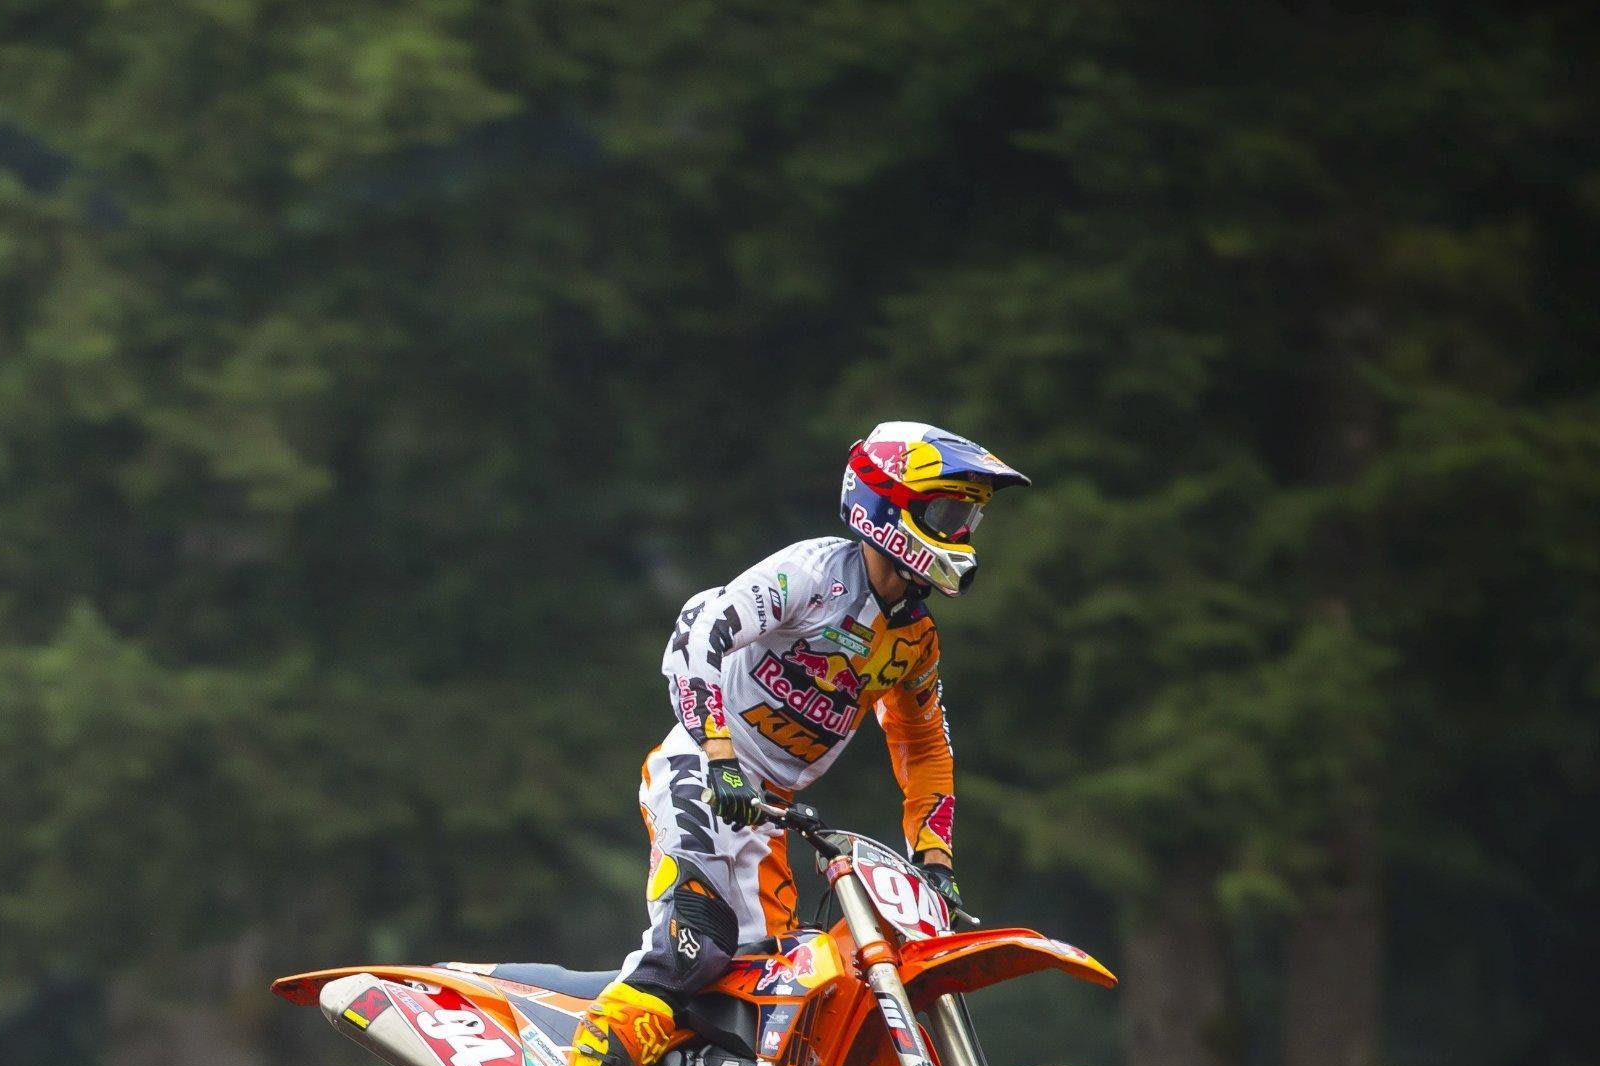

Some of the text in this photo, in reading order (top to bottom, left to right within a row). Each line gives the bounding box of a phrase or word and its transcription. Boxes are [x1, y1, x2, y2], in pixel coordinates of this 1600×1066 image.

[850, 503, 935, 575] Red Bull
[754, 656, 857, 737] Red Bull
[742, 705, 830, 764] KTM
[667, 754, 719, 856] KTM
[872, 866, 945, 932] 94
